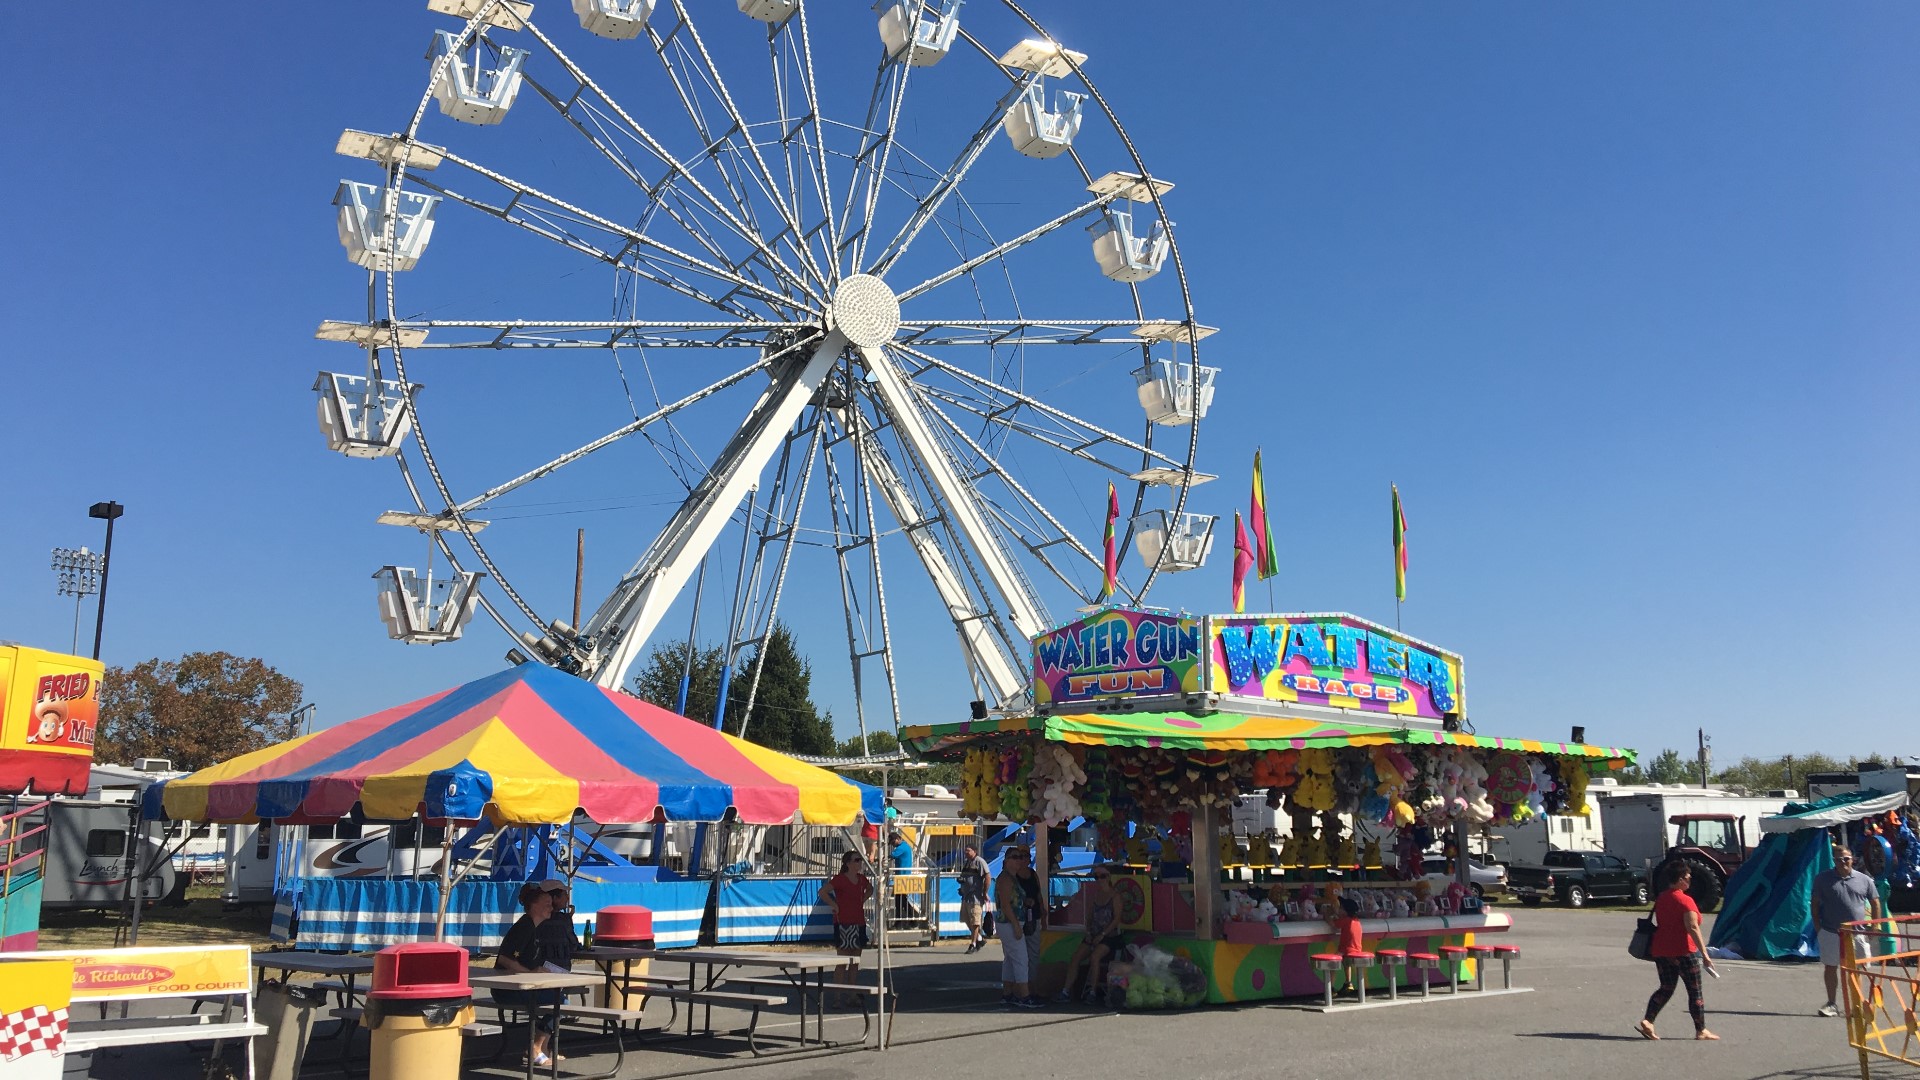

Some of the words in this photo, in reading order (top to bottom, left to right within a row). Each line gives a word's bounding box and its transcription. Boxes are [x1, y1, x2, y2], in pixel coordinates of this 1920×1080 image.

[1039, 618, 1130, 677] WATER
[1134, 619, 1200, 665] GUN
[1221, 623, 1456, 712] WATER
[37, 672, 90, 703] FRIED
[1068, 668, 1165, 696] FUN
[1296, 675, 1397, 701] RACE
[79, 858, 119, 877] Launch
[896, 878, 923, 893] ENTER
[90, 968, 154, 983] Richard's
[149, 984, 190, 993] FOOD
[195, 981, 245, 991] COURT
